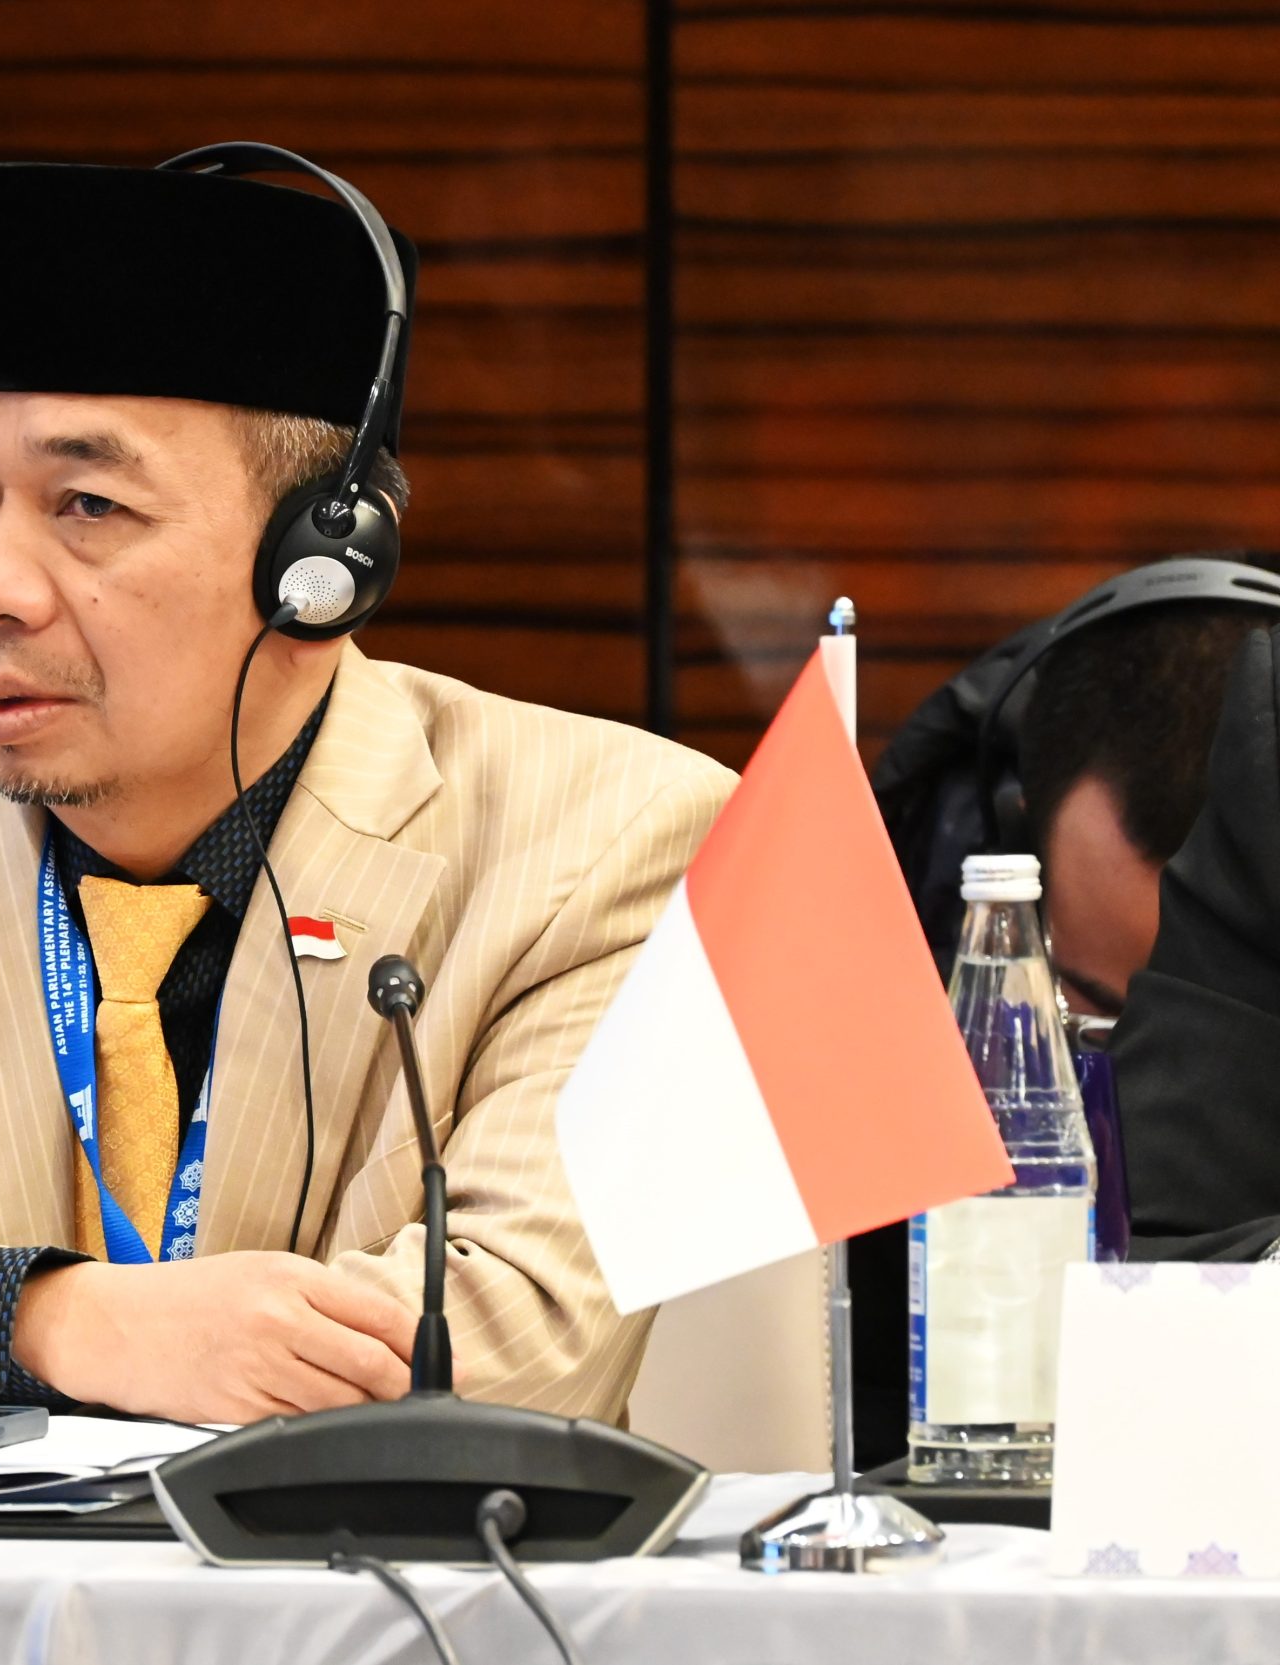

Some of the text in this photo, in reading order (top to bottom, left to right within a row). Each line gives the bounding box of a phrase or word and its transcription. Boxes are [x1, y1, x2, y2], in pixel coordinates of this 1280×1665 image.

[345, 546, 374, 569] BOSCH
[43, 900, 61, 1010] PARLIAMENTARY
[58, 913, 72, 970] PLENARY
[77, 942, 86, 962] 2024
[65, 1001, 75, 1027] THE
[80, 990, 89, 1034] FEBRUARY
[53, 1013, 68, 1055] ASIAN
